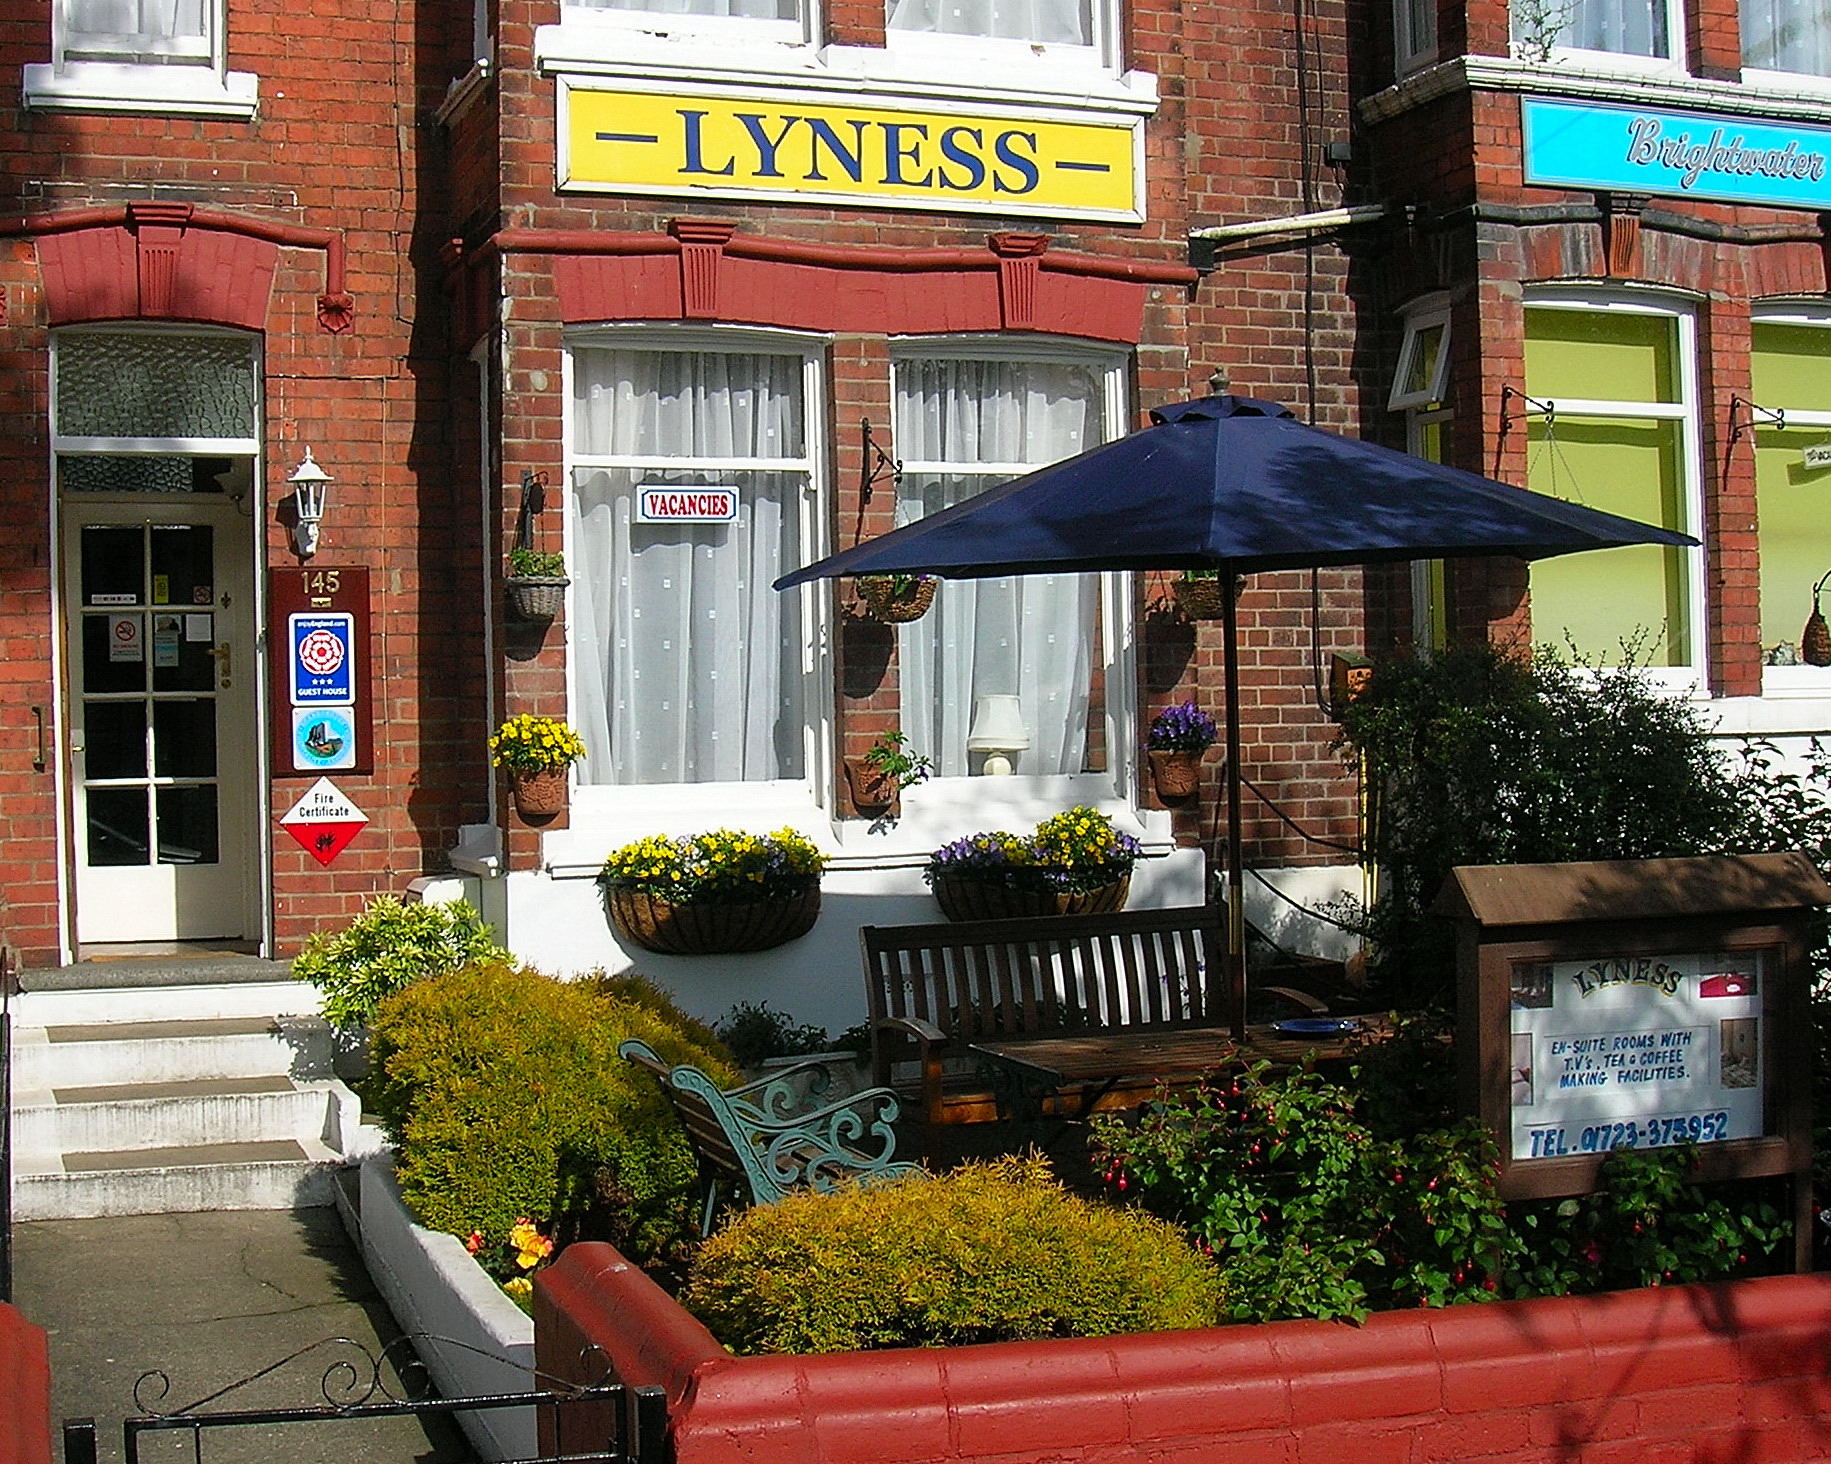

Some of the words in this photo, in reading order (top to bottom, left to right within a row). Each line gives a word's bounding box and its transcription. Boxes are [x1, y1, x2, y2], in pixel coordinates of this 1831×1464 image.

[675, 109, 1040, 194] LYNESS
[1627, 117, 1825, 189] Brightwater
[649, 494, 728, 515] VACANCIES
[301, 570, 340, 593] 145
[297, 687, 321, 696] GUEST
[322, 687, 348, 696] HOUSE
[314, 793, 334, 804] Fire
[299, 806, 349, 818] Certificate
[1572, 959, 1683, 999] LYNESS
[1551, 1038, 1606, 1055] EN-SUITE
[1613, 1034, 1655, 1050] ROOMS
[1661, 1031, 1692, 1047] WITH
[1604, 1053, 1625, 1068] TEA
[1640, 1049, 1683, 1066] COFFEE
[1559, 1071, 1609, 1088] MAKING
[1617, 1065, 1690, 1083] FACILITIES.
